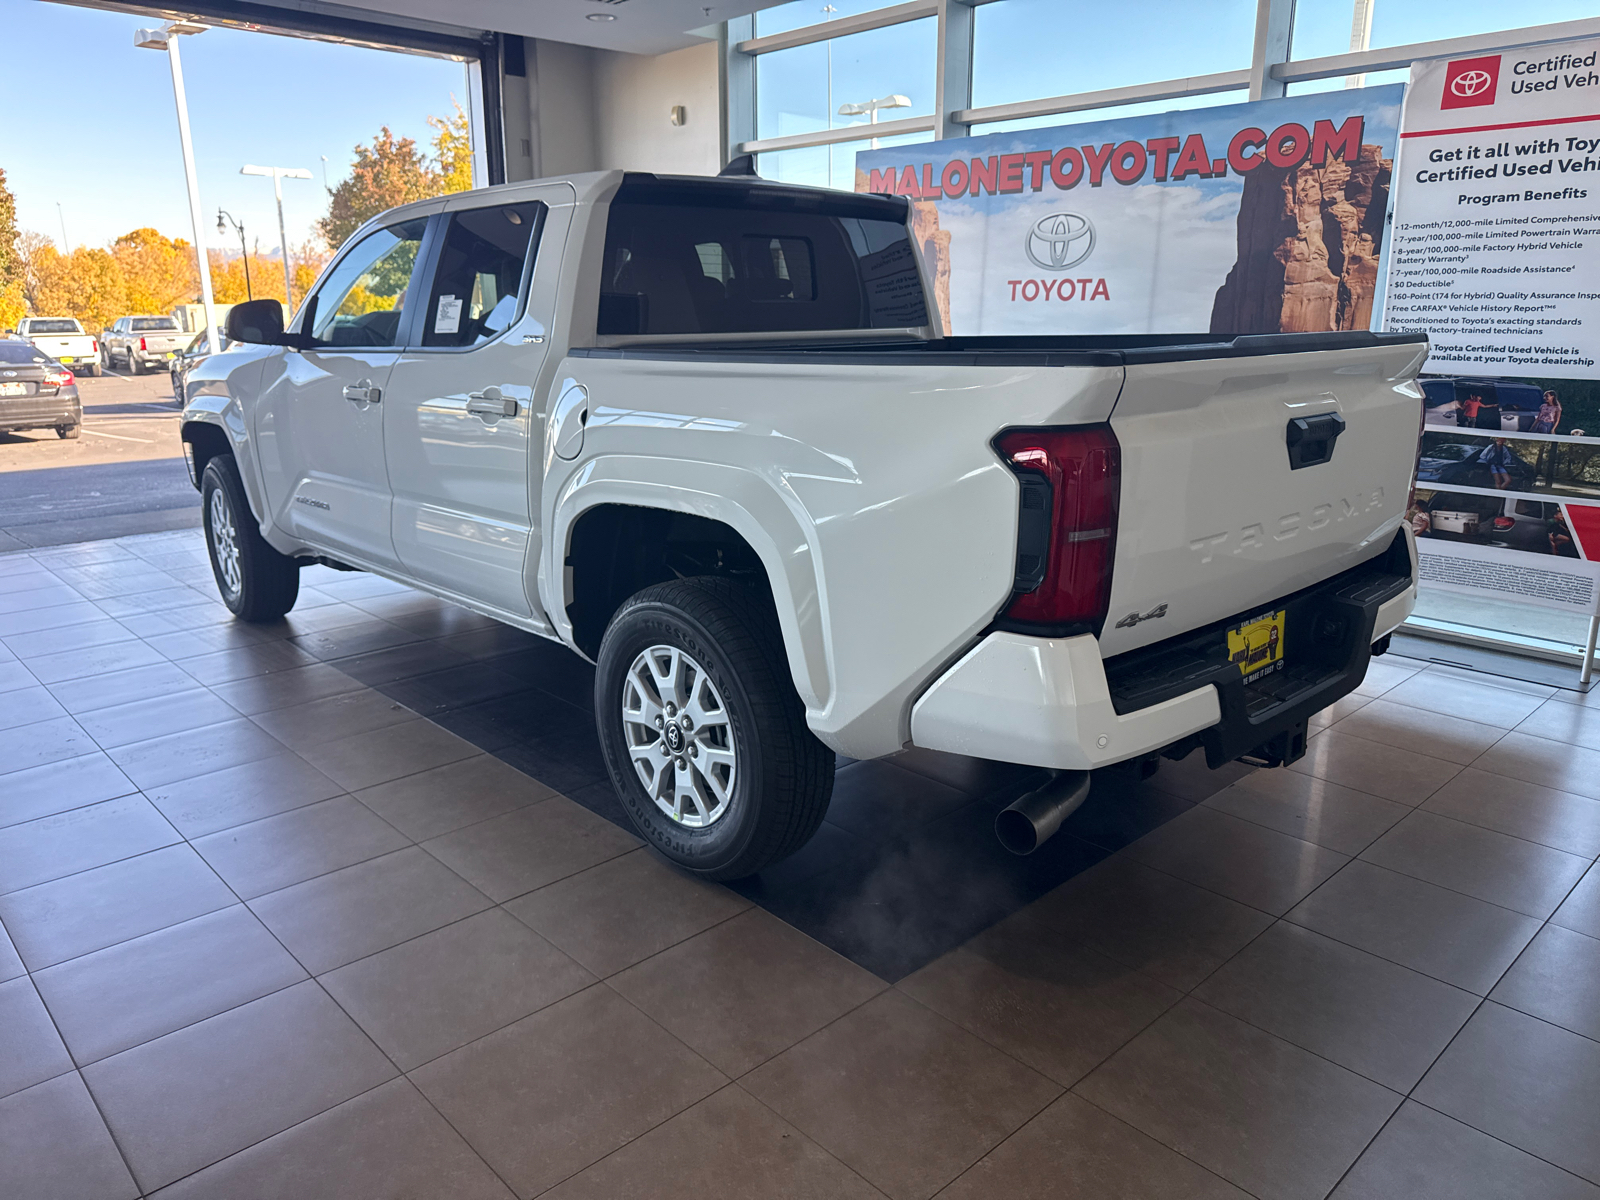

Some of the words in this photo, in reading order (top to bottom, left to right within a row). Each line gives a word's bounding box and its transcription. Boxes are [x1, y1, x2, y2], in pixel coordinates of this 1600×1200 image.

[1513, 51, 1597, 75] Certified
[1511, 75, 1558, 94] Used
[1563, 71, 1600, 88] Veh
[1429, 149, 1463, 163] Get
[1467, 145, 1480, 160] it
[1485, 142, 1509, 159] all
[1515, 138, 1560, 157] with
[1565, 137, 1600, 154] Toy
[870, 115, 1364, 201] MALONETOYOTA.COM
[1416, 163, 1499, 183] Certified
[1502, 159, 1553, 177] Used
[1558, 156, 1600, 173] Vehi
[1458, 193, 1521, 207] Program
[1524, 187, 1588, 202] Benefits
[1400, 218, 1494, 231] 12-month/12,000-mile
[1495, 216, 1529, 226] Limited
[1399, 231, 1484, 244] 7-year/100,000-mile
[1485, 230, 1519, 239] Limited
[1520, 228, 1571, 238] Powertrain
[1397, 243, 1481, 256] 8-year/100,000-mile
[1482, 243, 1516, 254] Factory
[1517, 242, 1548, 252] Hybrid
[1549, 241, 1583, 250] Vehicle
[1396, 256, 1427, 266] Battery
[1395, 266, 1479, 278] 7-year/100,000-mile
[1480, 266, 1522, 275] Roadside
[1008, 278, 1111, 302] TOYOTA
[1394, 280, 1405, 289] $0
[1393, 292, 1431, 301] 160-Point
[1432, 292, 1449, 301] (174
[1450, 292, 1463, 300] for
[1464, 292, 1495, 302] Hybrid)
[1497, 292, 1528, 302] Quality
[1448, 304, 1479, 312] Vehicle
[1480, 304, 1512, 314] History
[1496, 318, 1534, 326] exacting
[1536, 318, 1582, 326] standards
[1429, 326, 1492, 335] factory-trained
[1493, 327, 1543, 335] technicians
[1434, 344, 1464, 353] Toyota
[1465, 344, 1506, 354] Certified
[1508, 345, 1532, 354] Used
[1534, 346, 1569, 355] Vehicle
[1571, 347, 1580, 355] is
[1431, 353, 1472, 362] available
[1484, 356, 1506, 364] your
[1508, 356, 1539, 365] Toyota
[1541, 356, 1595, 367] dealership
[1190, 486, 1385, 564] TACOMA
[643, 619, 714, 672] Firestone
[628, 798, 695, 858] Firestone
